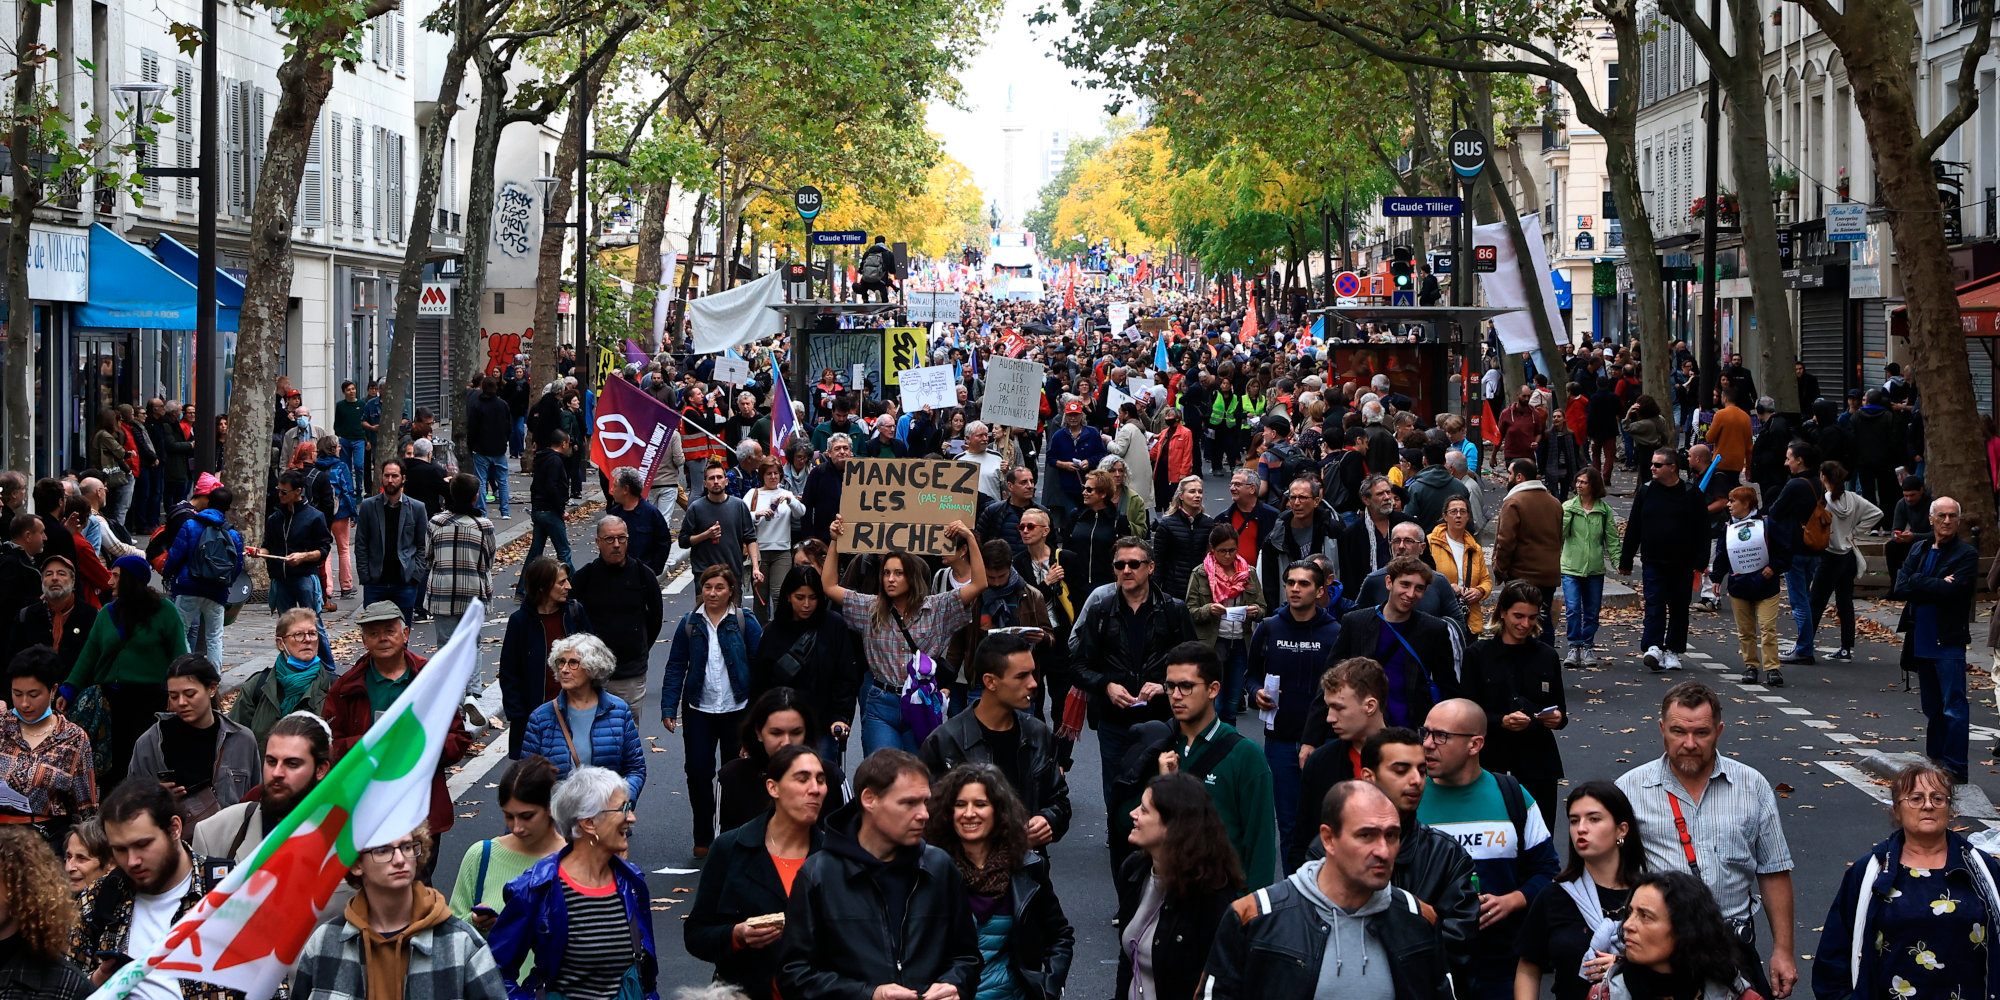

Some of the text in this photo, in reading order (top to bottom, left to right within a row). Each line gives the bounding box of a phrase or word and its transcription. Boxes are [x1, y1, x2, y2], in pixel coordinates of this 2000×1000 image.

[1454, 141, 1483, 157] BUS
[799, 193, 819, 205] BUS
[1391, 202, 1454, 212] Claude Tillier
[818, 234, 862, 242] Claude Tillier
[34, 231, 45, 269] de
[47, 233, 86, 273] VOYAGES
[1478, 248, 1494, 260] 86
[792, 266, 804, 275] 86
[1000, 359, 1034, 373] AUGMENTER
[1012, 373, 1023, 383] LES
[998, 383, 1030, 396] SALAIRES
[999, 395, 1027, 407] PAS LES
[987, 405, 1035, 420] ACTIONNAIRES
[845, 460, 978, 495] MANGEZ
[860, 490, 906, 513] LES
[940, 495, 953, 503] LES
